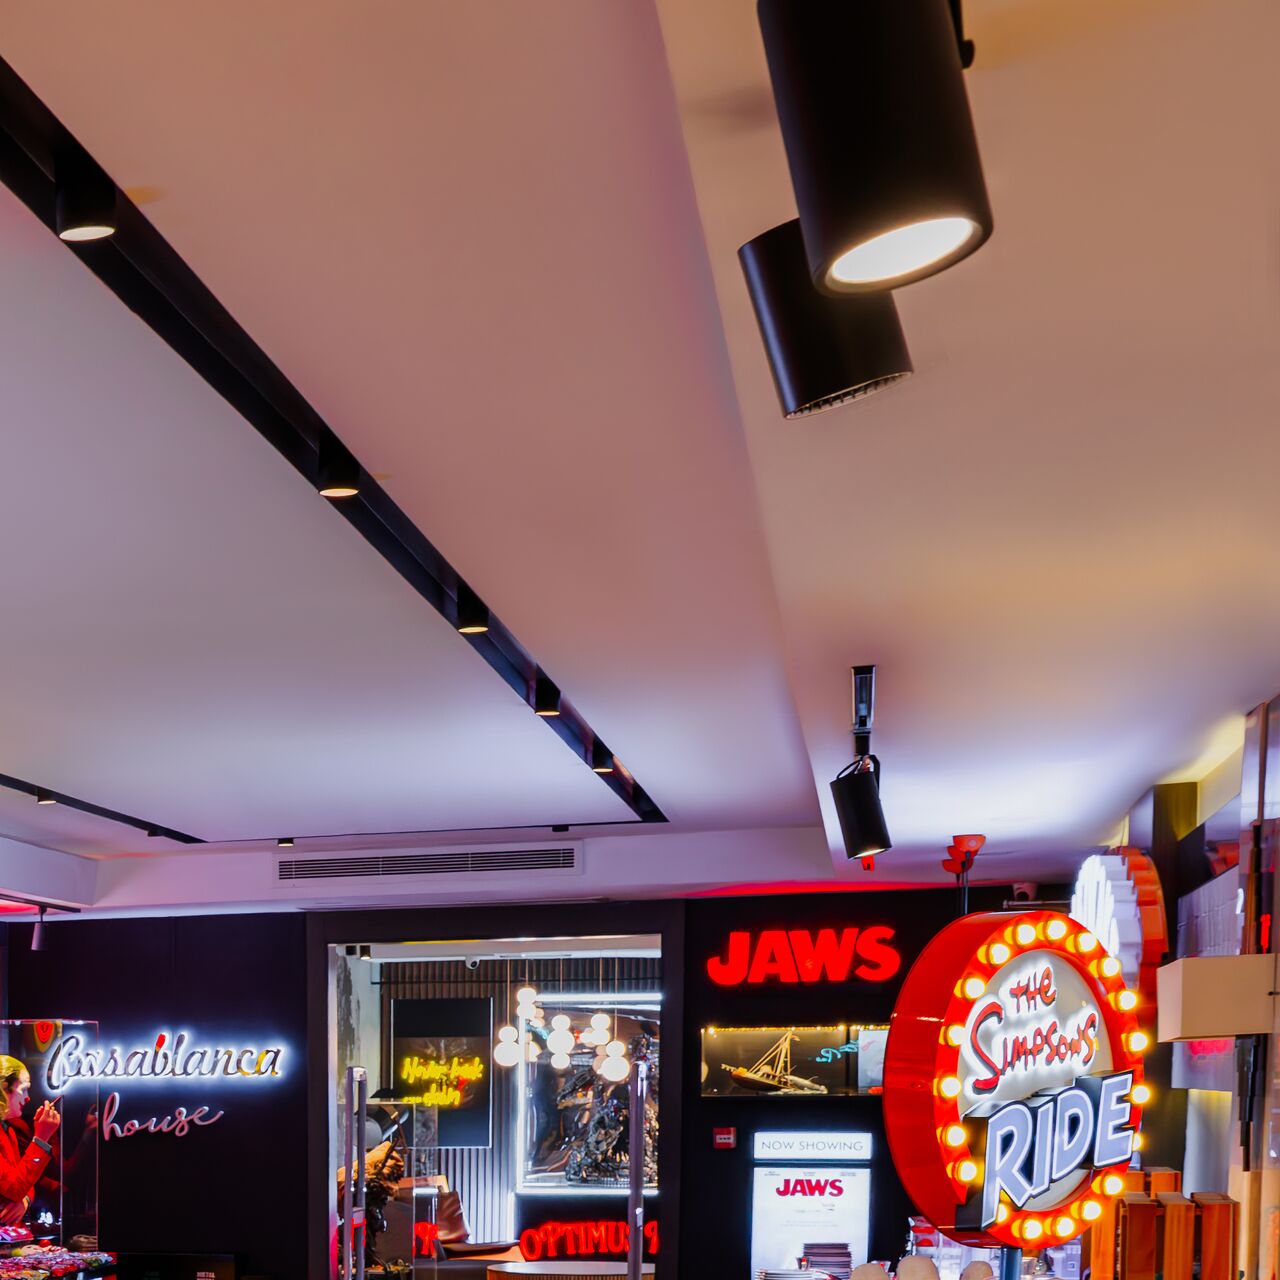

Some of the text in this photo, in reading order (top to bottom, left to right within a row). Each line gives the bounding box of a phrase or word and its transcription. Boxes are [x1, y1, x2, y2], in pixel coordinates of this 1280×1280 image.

[707, 926, 901, 986] JAWS
[46, 1032, 283, 1090] Casablanca
[102, 1091, 225, 1141] house
[761, 1140, 864, 1152] NOW SHOWING
[980, 1072, 1134, 1231] RIDE
[775, 1178, 844, 1197] JAWS
